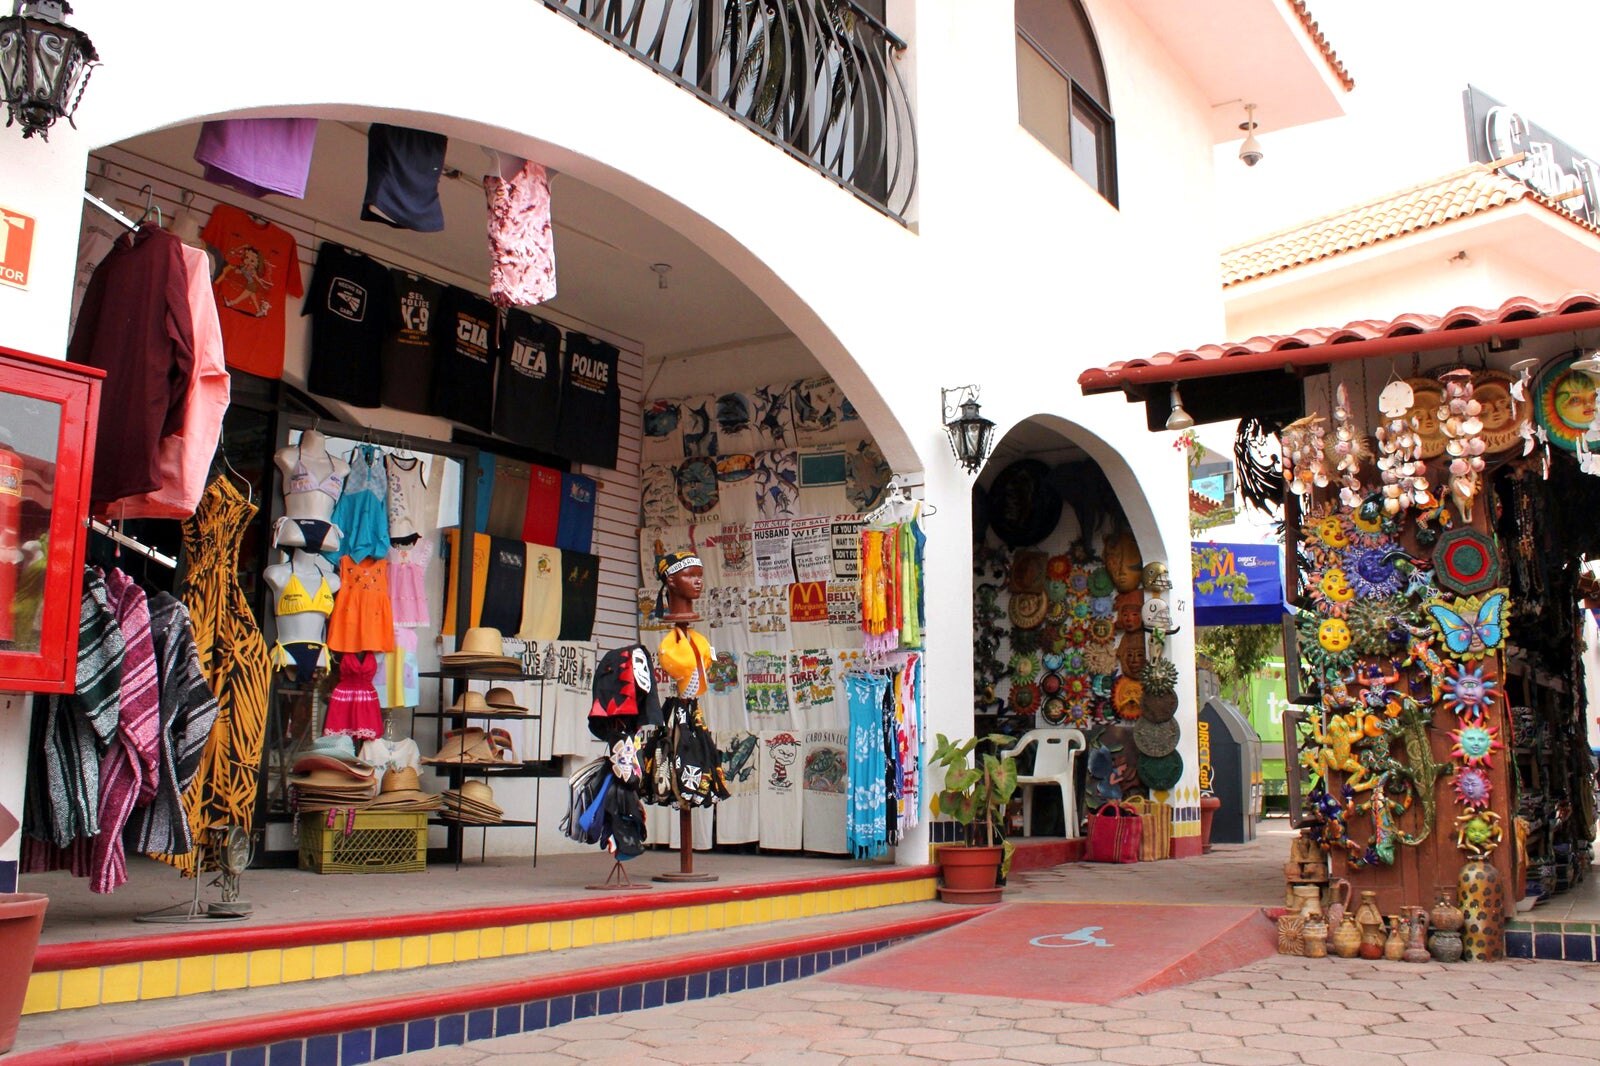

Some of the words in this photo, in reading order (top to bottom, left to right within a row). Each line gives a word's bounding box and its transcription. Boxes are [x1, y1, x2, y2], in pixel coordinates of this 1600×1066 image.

[401, 297, 429, 309] POLICE
[401, 304, 430, 331] K-9
[457, 319, 488, 350] CIA
[511, 341, 547, 373] DEA
[572, 353, 608, 383] POLICE
[754, 528, 789, 540] HUSBAND
[792, 526, 830, 538] WIFE
[841, 525, 852, 533] YOU
[836, 538, 848, 546] WANT
[828, 592, 856, 601] BELLY
[560, 645, 577, 660] OLD
[557, 671, 578, 686] RULE
[744, 673, 786, 684] TEQUILA
[790, 670, 820, 685] THREE
[805, 733, 823, 744] CABO
[824, 732, 835, 743] SAN
[1198, 721, 1210, 766] DIRECT
[1200, 763, 1211, 790] Cash
